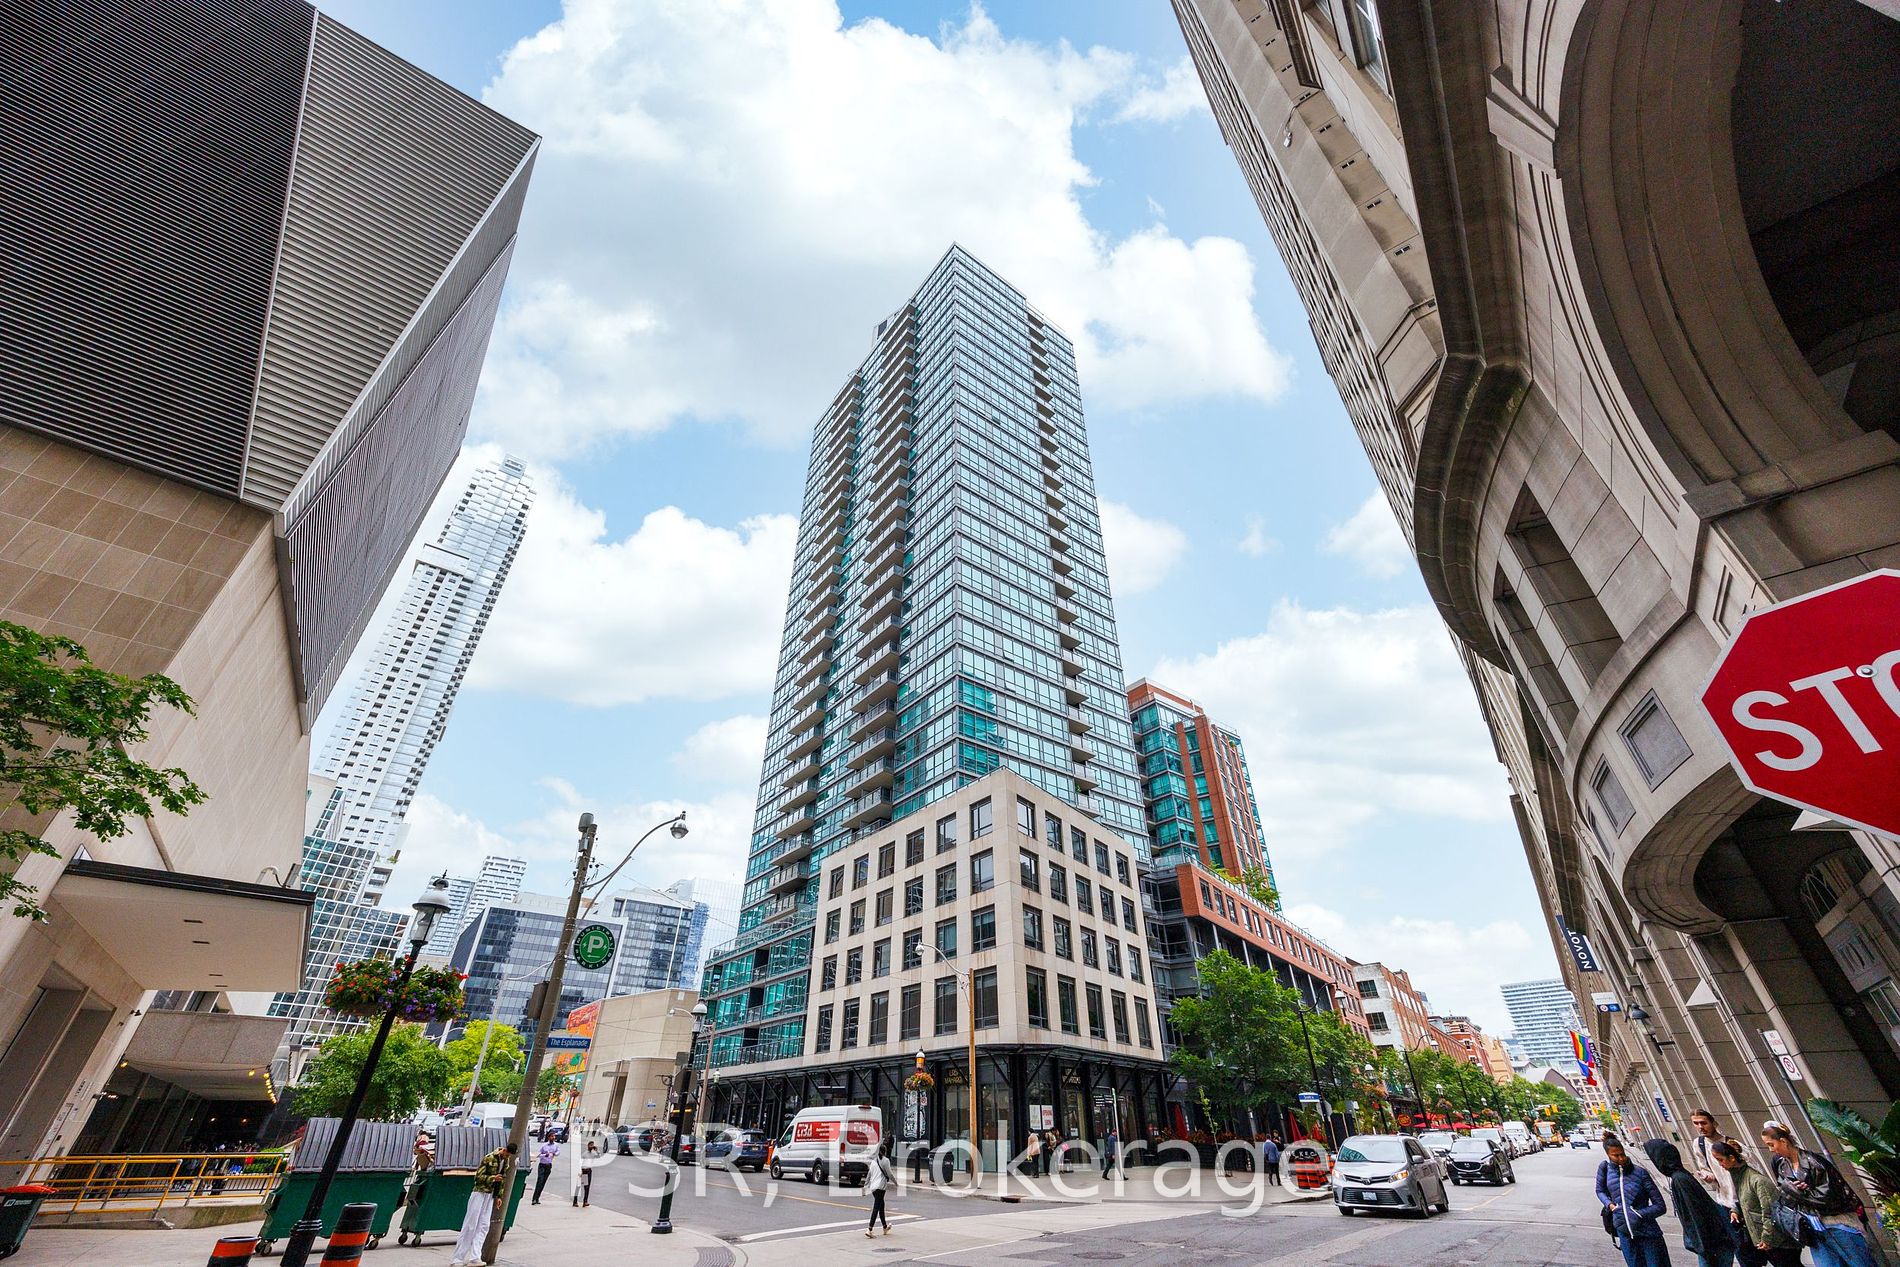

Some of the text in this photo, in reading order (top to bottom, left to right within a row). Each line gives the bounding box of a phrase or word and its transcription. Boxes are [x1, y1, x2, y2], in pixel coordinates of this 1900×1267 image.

[587, 935, 604, 954] P
[1566, 928, 1592, 969] NOVOT
[551, 1038, 588, 1047] The Esplanade
